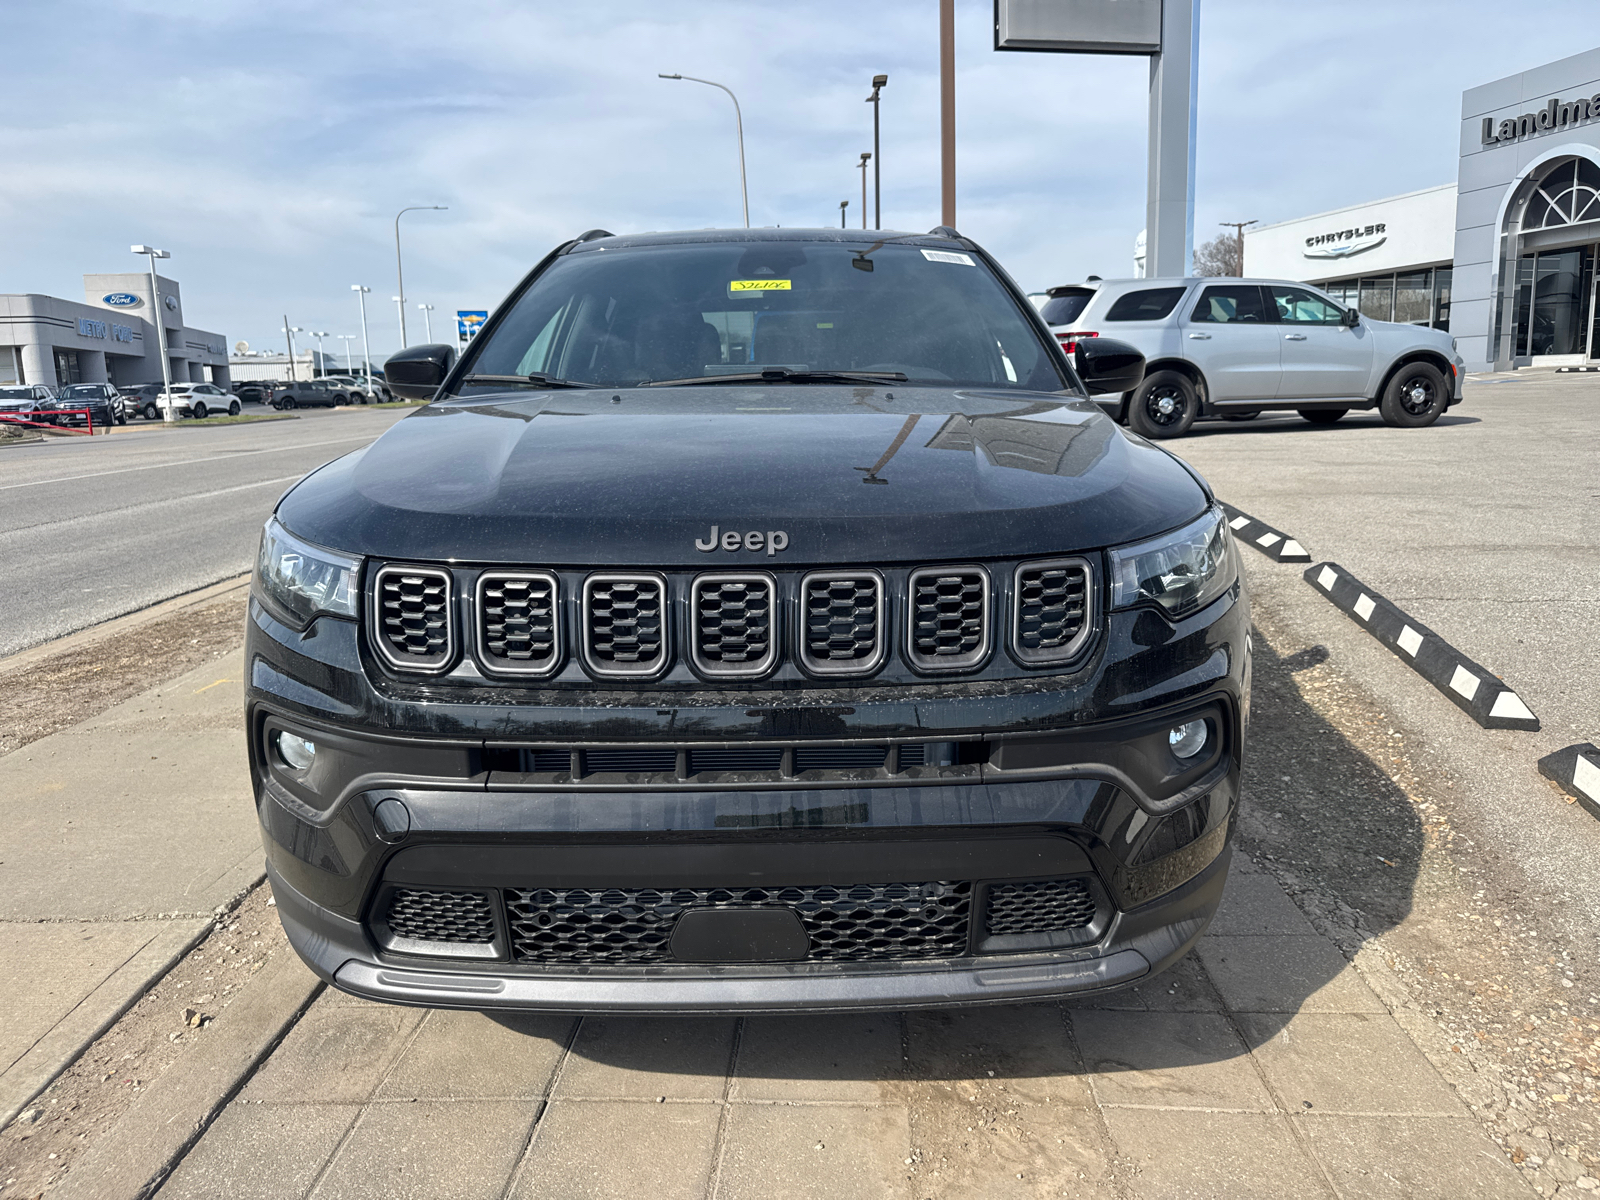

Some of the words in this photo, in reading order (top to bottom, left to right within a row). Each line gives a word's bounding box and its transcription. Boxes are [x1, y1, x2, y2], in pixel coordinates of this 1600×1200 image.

[1305, 223, 1386, 247] CHRYSLER
[109, 295, 131, 304] Ford
[78, 317, 107, 339] METRO
[112, 323, 133, 343] FORD
[695, 525, 789, 557] Jeep
